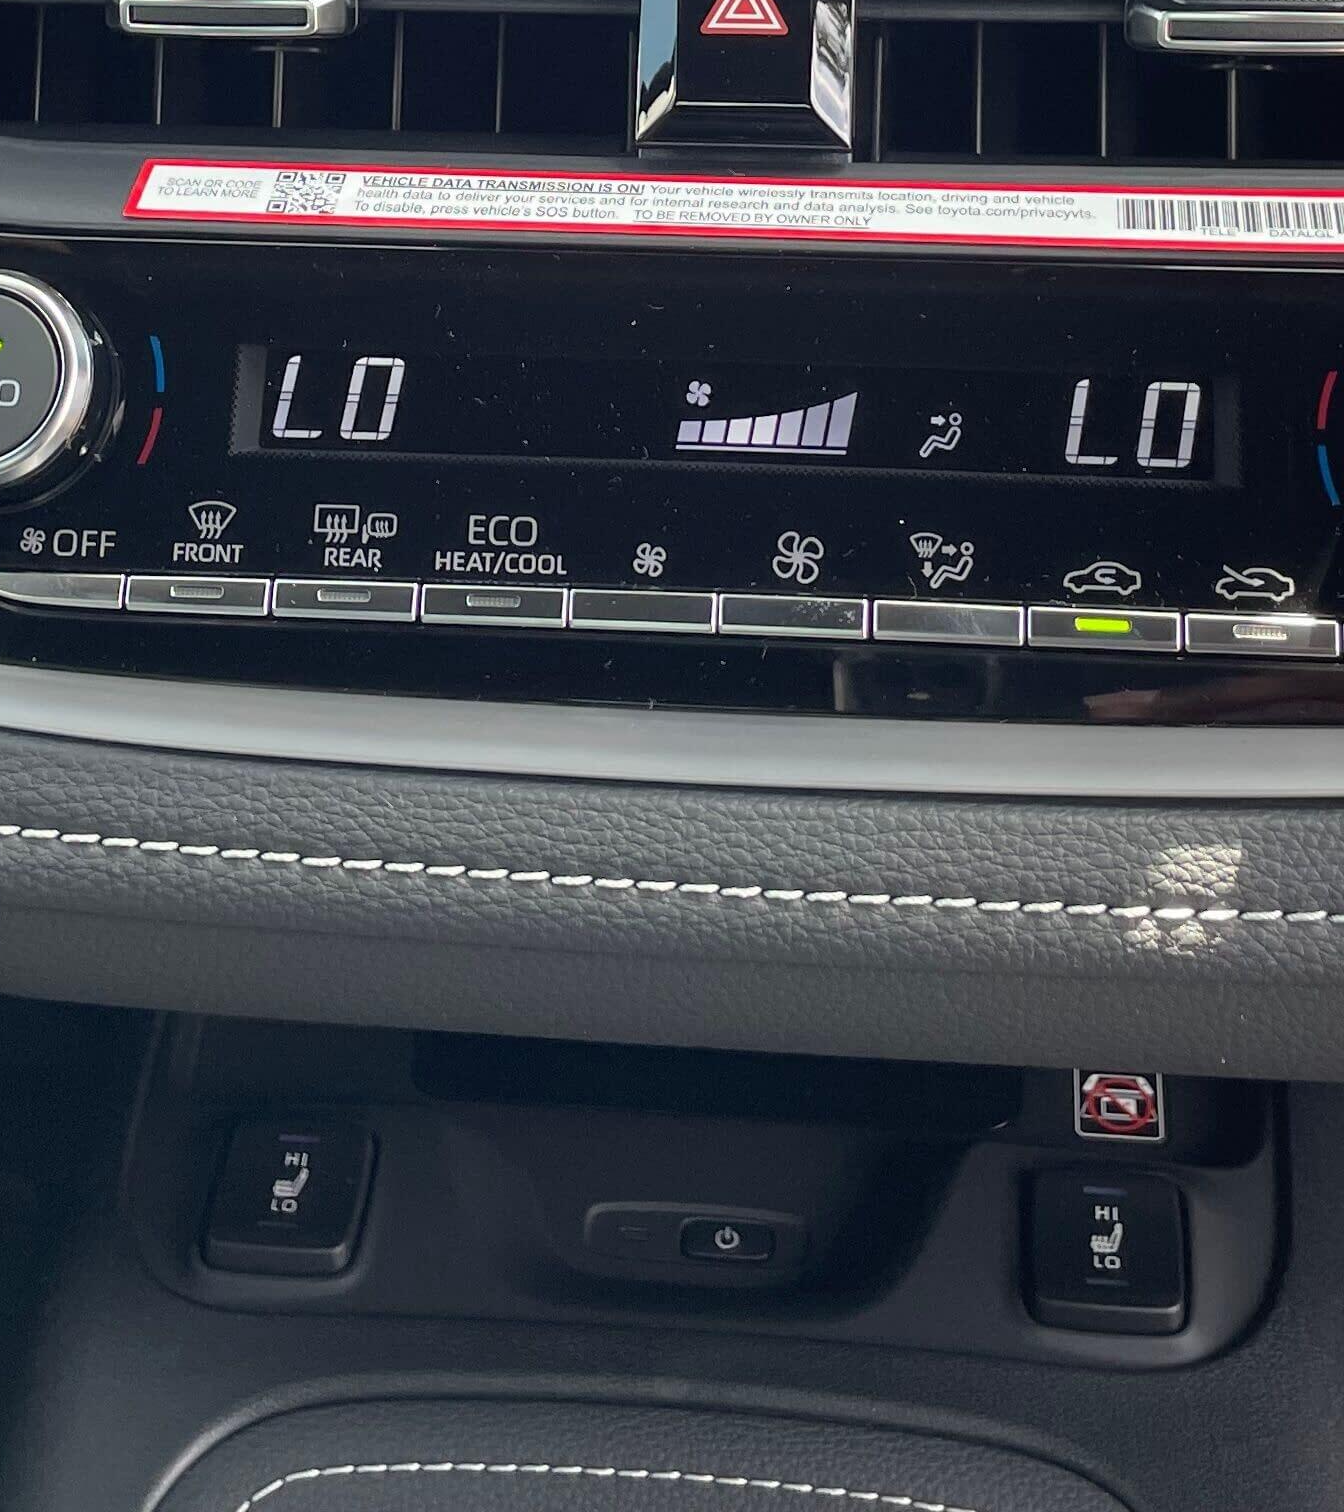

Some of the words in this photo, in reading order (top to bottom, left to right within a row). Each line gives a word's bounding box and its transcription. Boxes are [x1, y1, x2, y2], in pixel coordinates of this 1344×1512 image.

[158, 186, 173, 196] TO
[174, 187, 219, 197] LEARN
[221, 188, 258, 199] MORE
[167, 177, 202, 188] SCAN
[224, 179, 263, 189] CODE
[362, 175, 428, 188] VEHICLE
[432, 177, 473, 189] DATA
[475, 179, 594, 193] TRANSMISSION
[598, 183, 613, 194] IS
[617, 183, 645, 195] ON!
[650, 185, 682, 196] Your
[685, 185, 734, 197] vehicle
[737, 187, 805, 201] wirelessly
[810, 190, 874, 201] transmits
[878, 191, 937, 204] location,
[942, 193, 988, 207] driving
[993, 194, 1020, 205] and
[1025, 195, 1075, 206] vehicle
[355, 199, 371, 211] To
[373, 200, 426, 215] disable,
[431, 205, 469, 216] press
[472, 205, 532, 218] vehicle's
[535, 206, 569, 218] SOS
[572, 207, 620, 219] button.
[634, 209, 653, 220] TO
[656, 209, 675, 221] BE
[679, 210, 751, 223] REMOVED
[754, 213, 774, 224] BY
[777, 213, 830, 225] OWNER
[834, 215, 872, 227] ONLY
[357, 188, 399, 200] health
[402, 189, 434, 200] data
[438, 191, 452, 201] to
[455, 191, 502, 203] deliver
[505, 195, 534, 206] your
[538, 194, 595, 206] services
[599, 195, 625, 206] and
[629, 196, 648, 207] for
[652, 197, 704, 208] internal
[708, 198, 769, 211] research
[772, 200, 800, 211] and
[803, 200, 835, 212] data
[905, 203, 933, 215] See
[1200, 226, 1236, 237] TELE
[272, 355, 406, 442] LO
[1064, 378, 1201, 467] LO
[468, 515, 539, 548] ECO
[52, 531, 117, 559] OFF
[172, 543, 244, 564] FRONT
[324, 547, 382, 570] REAR
[434, 551, 568, 576] HEAT/COOL
[284, 1152, 308, 1167] HI
[270, 1198, 298, 1213] LO
[1094, 1205, 1119, 1221] HI
[1092, 1255, 1121, 1271] LO
